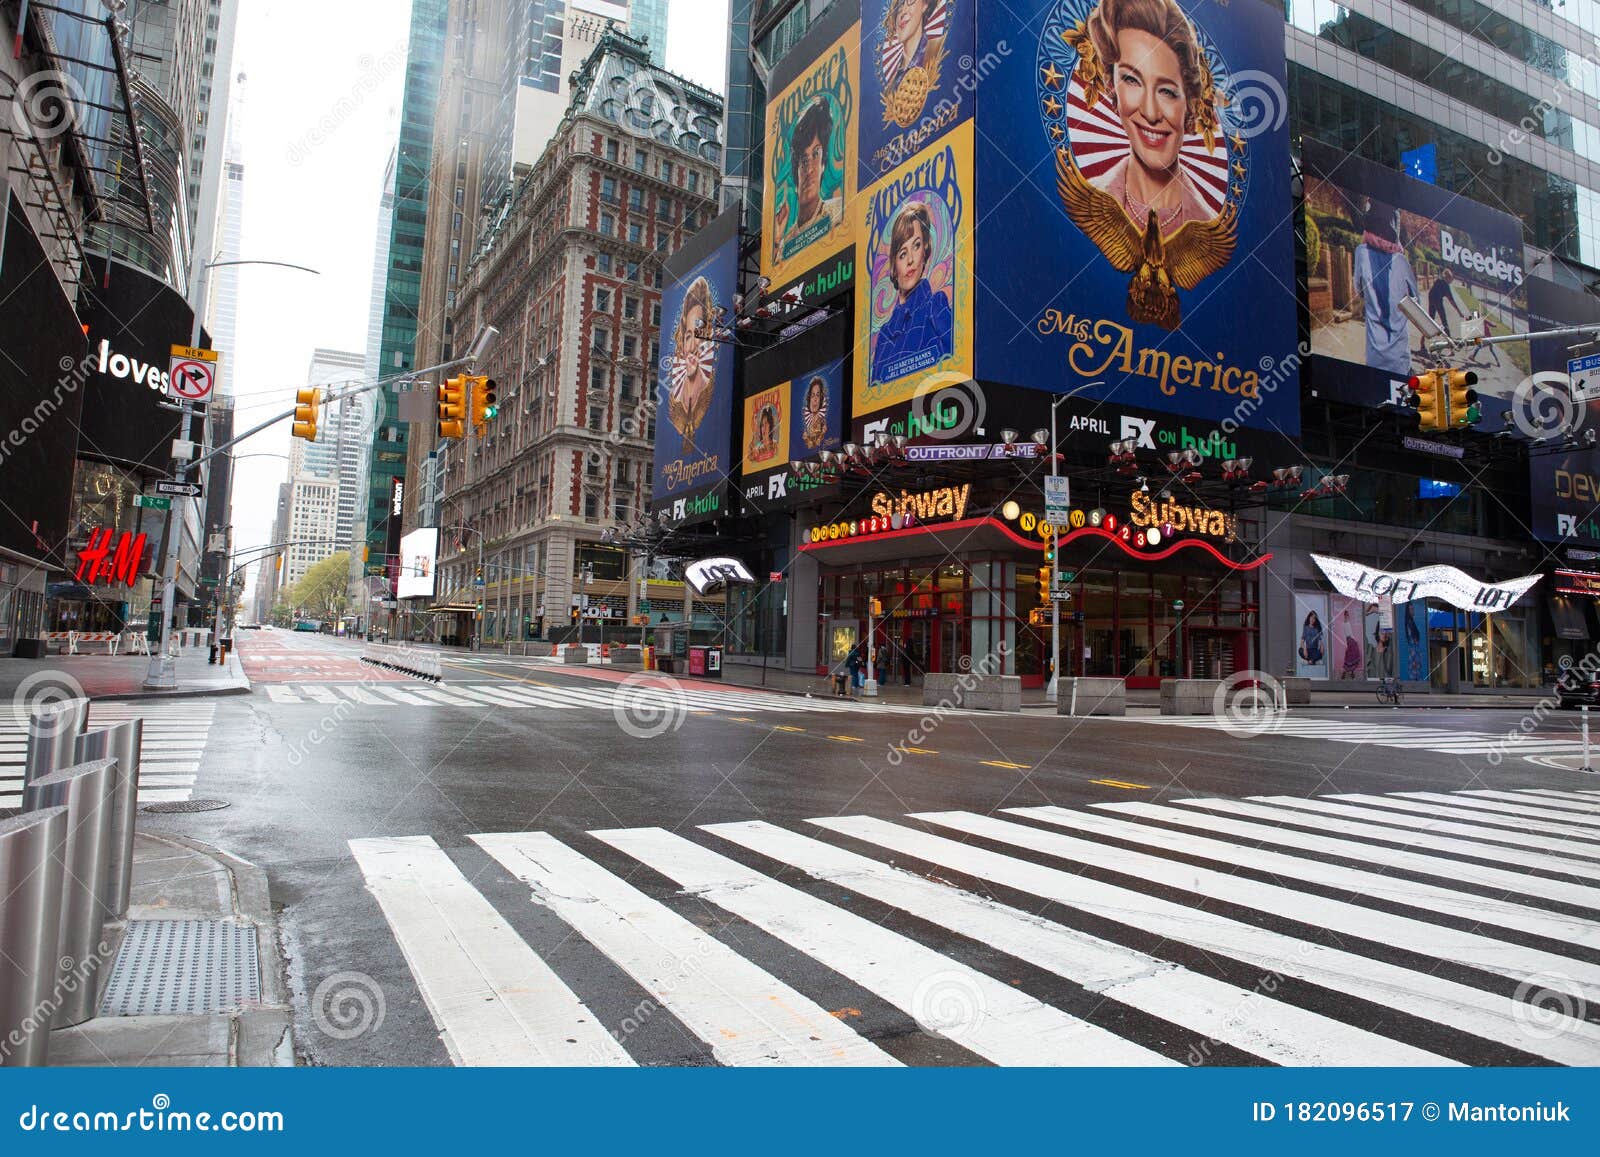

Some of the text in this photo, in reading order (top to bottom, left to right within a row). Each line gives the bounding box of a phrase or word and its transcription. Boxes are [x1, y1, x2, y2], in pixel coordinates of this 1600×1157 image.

[1441, 230, 1523, 286] Breeders
[817, 261, 853, 296] hulu
[185, 348, 205, 358] NEW
[1038, 308, 1259, 399] Mrs. America
[891, 420, 904, 437] ON
[907, 401, 957, 439] hulu
[1070, 415, 1237, 460] APRIL FX ON hulu
[667, 453, 718, 490] America
[908, 448, 986, 460] OUTFRONT
[393, 483, 403, 515] verizon
[745, 485, 765, 499] APRIL
[768, 472, 788, 500] FX
[872, 483, 971, 521] Subway
[673, 498, 687, 521] FX
[695, 491, 719, 515] hulu
[1131, 490, 1239, 544] Subway
[1557, 513, 1578, 537] FX
[75, 527, 148, 588] H&M
[1355, 571, 1515, 609] LOFT LOFT
